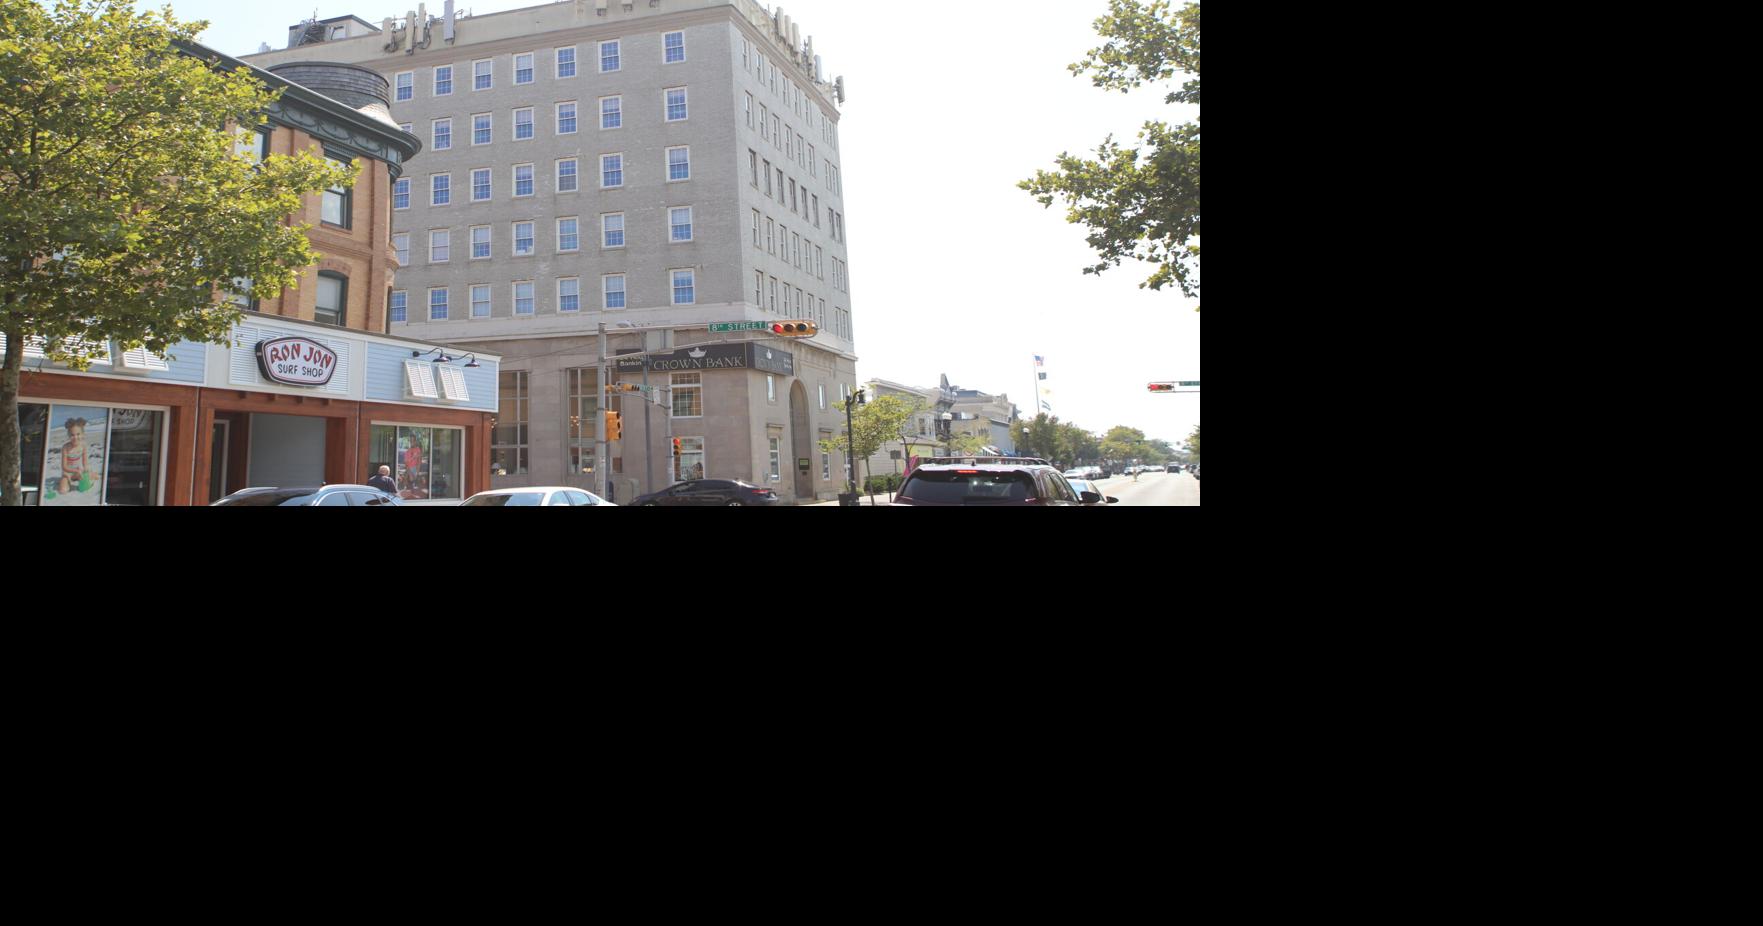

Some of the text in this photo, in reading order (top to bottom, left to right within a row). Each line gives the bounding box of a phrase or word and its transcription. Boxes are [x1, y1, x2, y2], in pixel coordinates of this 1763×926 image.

[727, 320, 764, 331] STREET
[270, 343, 333, 368] RON JON
[653, 359, 701, 370] CROWN
[706, 356, 744, 369] BANK
[277, 363, 324, 378] SURF SHOP
